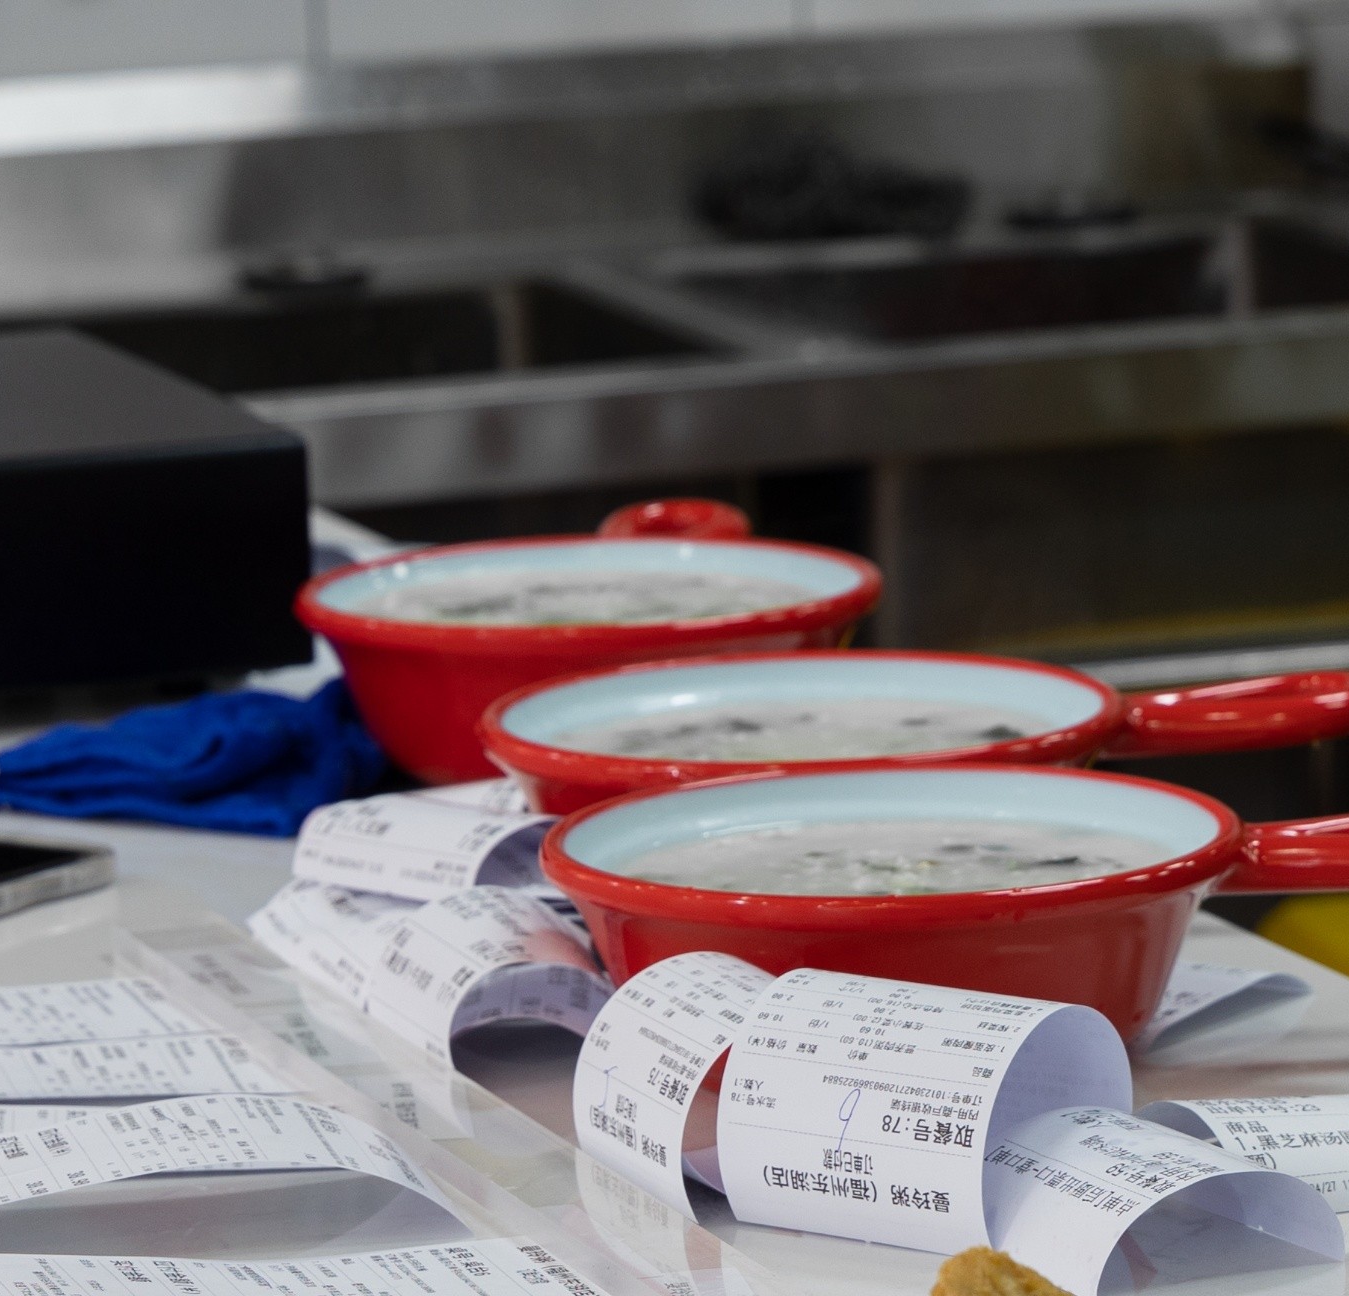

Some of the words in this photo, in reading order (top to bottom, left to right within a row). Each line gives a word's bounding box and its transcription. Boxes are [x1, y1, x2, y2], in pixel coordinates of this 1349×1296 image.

[769, 992, 794, 1001] 2.00
[755, 1011, 784, 1021] 10.60
[872, 1006, 897, 1015] 2.00
[806, 1018, 831, 1029] 1/份
[857, 1025, 887, 1036] 10.60
[794, 1042, 819, 1053] 数量
[938, 1037, 1006, 1053] 1.皮蛋瘦肉粥
[845, 1048, 869, 1060] 单价
[971, 1066, 994, 1079] 商品
[727, 1090, 777, 1109] 流水号:78
[878, 1113, 975, 1148] 取餐号:78
[1223, 1120, 1269, 1134] 商品
[818, 1147, 876, 1175] 订单已付款
[1102, 1160, 1177, 1196] 取餐号:59
[108, 1260, 153, 1282] 实付金额
[150, 1260, 204, 1294] 应付金额(¥)
